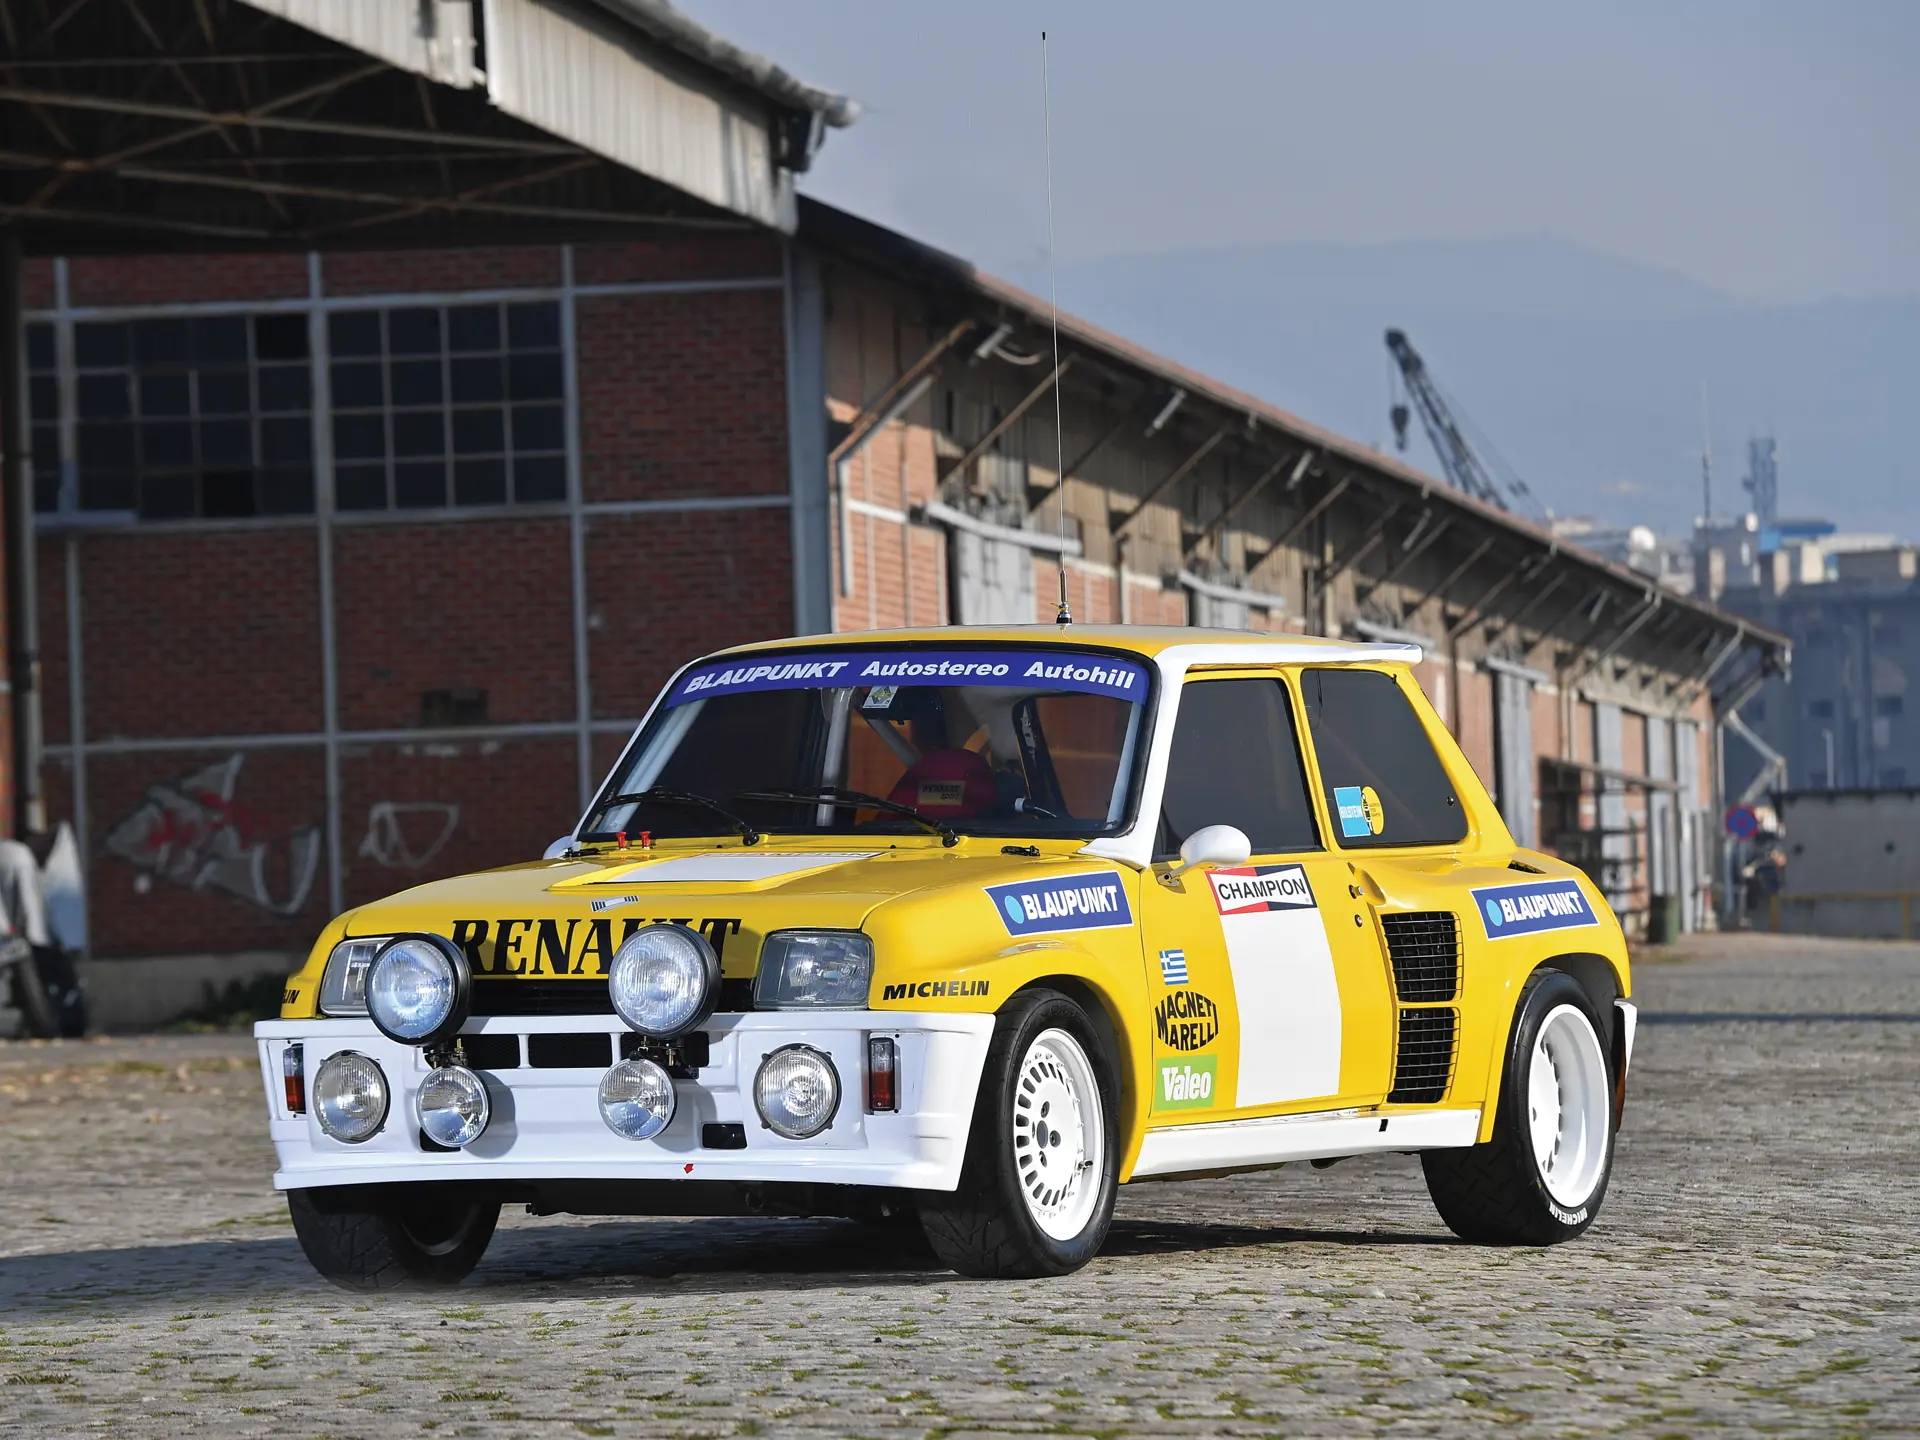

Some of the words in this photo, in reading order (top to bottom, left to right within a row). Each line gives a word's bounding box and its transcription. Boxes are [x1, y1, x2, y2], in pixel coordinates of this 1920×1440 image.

[683, 661, 850, 694] BLAUPUNKT
[860, 659, 1009, 678] Autostereo
[1023, 661, 1135, 690] Autohill
[1024, 885, 1118, 921] BLAUPUNKT
[1217, 878, 1307, 901] CHAMPION
[1499, 891, 1585, 923] BLAUPUNKT
[451, 918, 742, 975] RENAT
[882, 980, 990, 1001] MICHELIN
[1155, 990, 1218, 1022] MAGNETI
[1156, 1020, 1219, 1051] MARELLI
[1161, 1065, 1212, 1102] Valeo
[1548, 1201, 1588, 1225] MICHELIN
